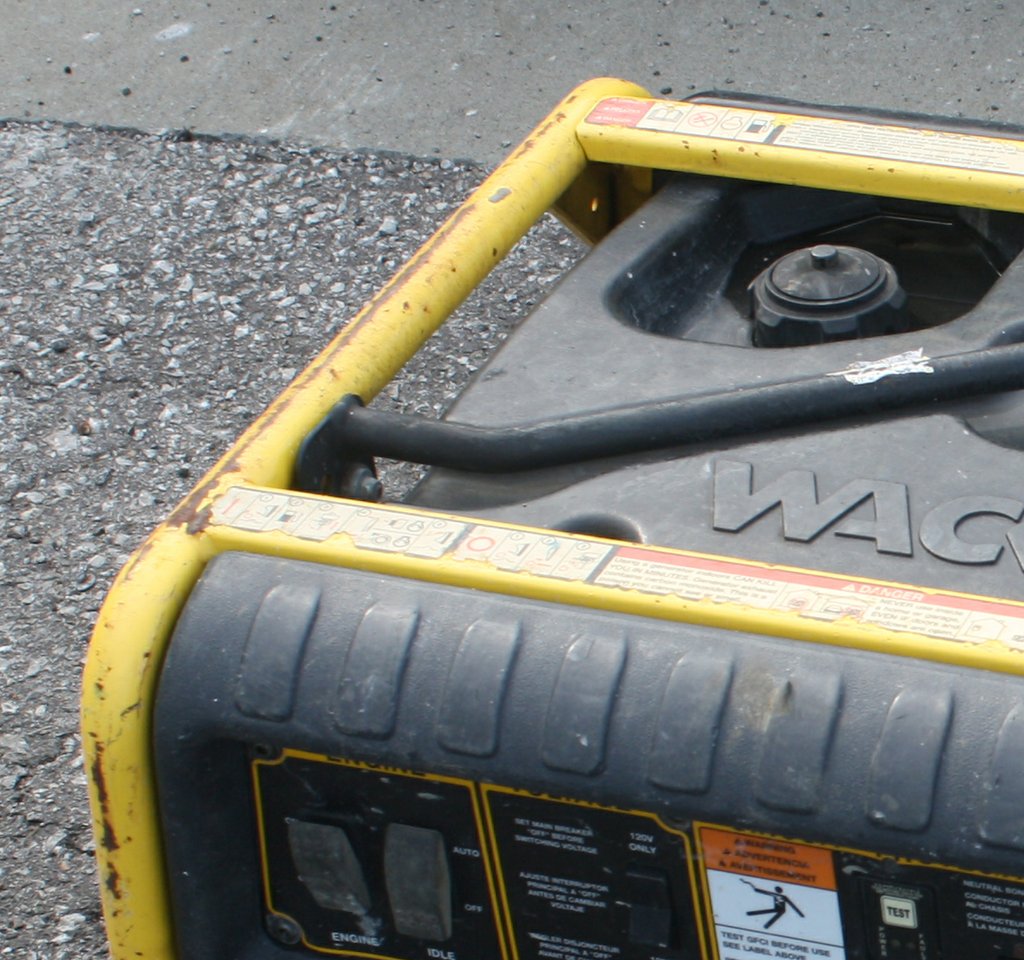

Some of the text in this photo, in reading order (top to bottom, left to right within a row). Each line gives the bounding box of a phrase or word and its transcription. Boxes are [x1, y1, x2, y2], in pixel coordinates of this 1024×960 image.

[859, 585, 925, 601] DANGER
[515, 818, 594, 837] SET MAIN BREAKER
[551, 833, 584, 844] BEFORE
[630, 832, 653, 843] 120V
[515, 835, 598, 855] SWITCHING VOLTAGE
[629, 843, 656, 854] ONLY
[453, 846, 480, 858] AUTO
[520, 871, 609, 892] AJUSTE INTERRUPTOR
[527, 881, 568, 894] PRINCIPAL
[963, 880, 1003, 893] NEUTRAL
[528, 890, 555, 900] ANTES
[568, 897, 607, 908] CAMBIAR
[964, 892, 1020, 907] CONDUCTOR
[465, 904, 483, 913] OFF
[551, 902, 586, 913] VOLTAJE
[887, 906, 910, 919] TEST
[979, 903, 1011, 915] CHASIS
[989, 925, 1019, 936] MASSE
[332, 932, 379, 946] ENGINE
[564, 938, 620, 953] DISJONCTEUR
[721, 932, 831, 957] TEST GFCI BEFORE USE
[428, 948, 456, 960] IDLE
[539, 950, 563, 960] AVANT
[540, 942, 581, 955] PRINCIPAL
[723, 941, 740, 950] SEE
[744, 945, 772, 956] LABEL
